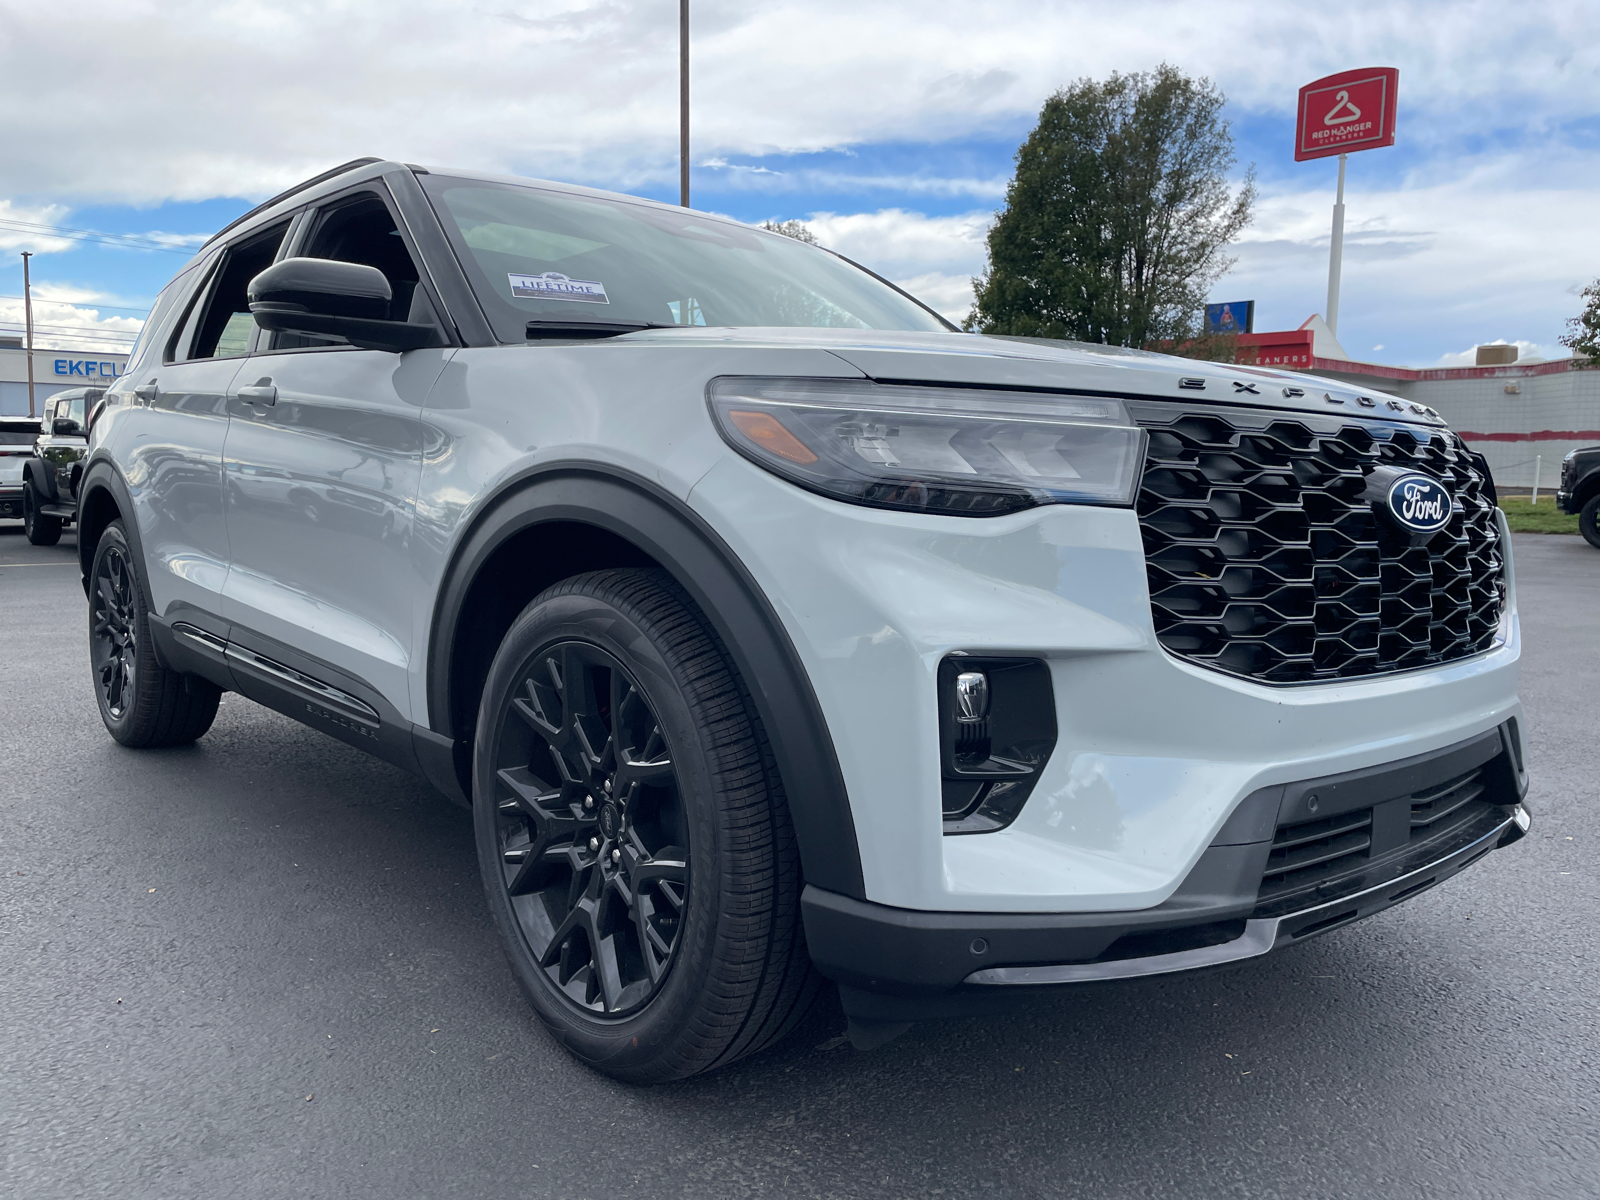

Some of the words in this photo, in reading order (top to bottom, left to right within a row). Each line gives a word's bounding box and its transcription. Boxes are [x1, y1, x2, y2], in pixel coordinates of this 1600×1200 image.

[1312, 130, 1330, 140] RED
[1331, 122, 1372, 136] HANGER
[1319, 131, 1364, 143] CLEANERS
[521, 281, 594, 293] LIFETIME
[1402, 483, 1443, 520] Ford
[305, 704, 379, 742] EXPLORER
